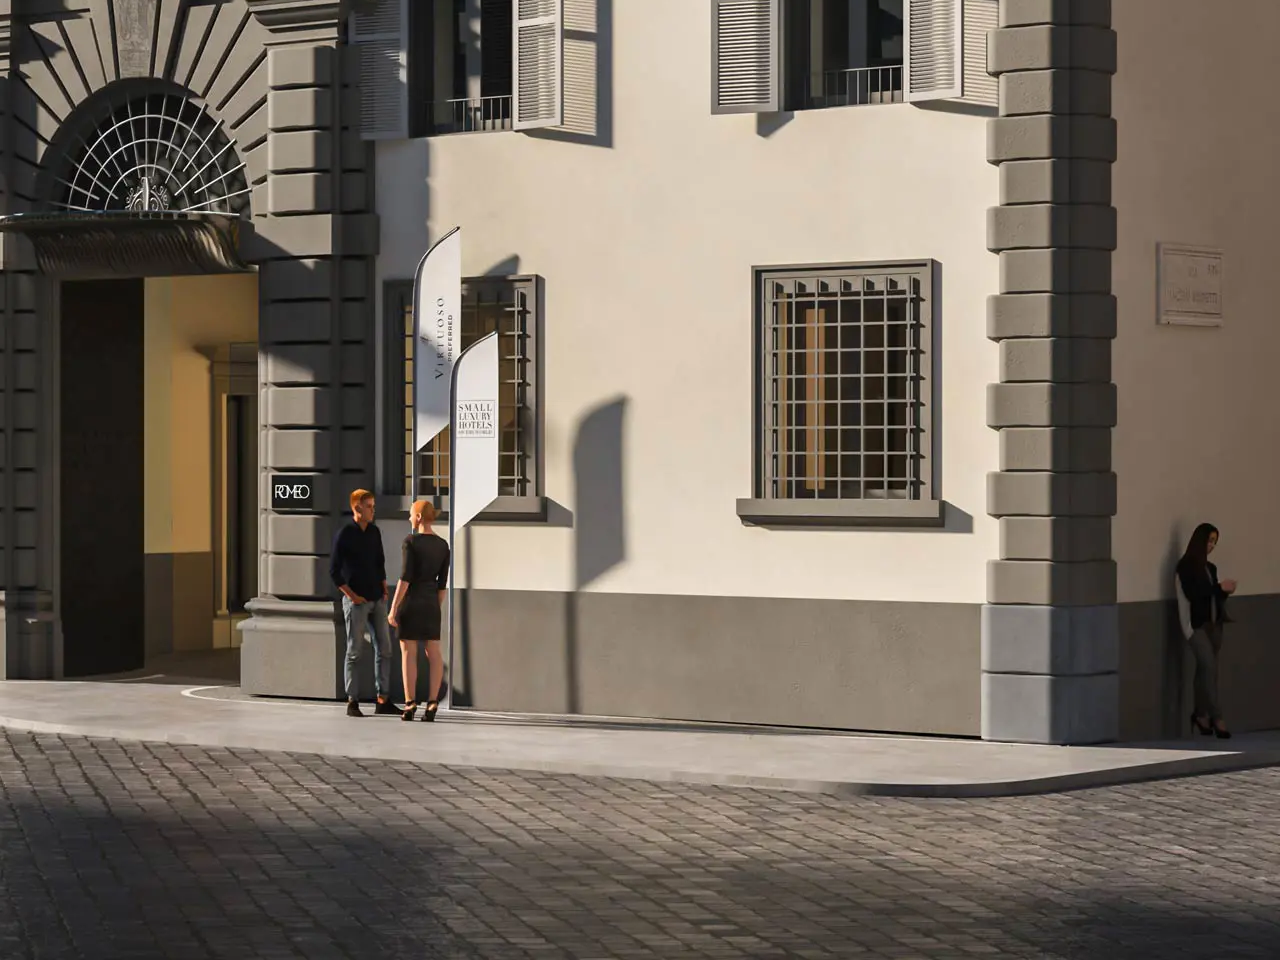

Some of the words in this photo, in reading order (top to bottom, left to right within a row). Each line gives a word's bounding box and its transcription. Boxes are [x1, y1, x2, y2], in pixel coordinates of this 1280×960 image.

[434, 297, 445, 380] VIRTUOSO
[458, 403, 493, 412] SMALL
[458, 412, 492, 421] LUXURY
[458, 421, 493, 430] HOTELS
[274, 484, 311, 500] ROMEO
